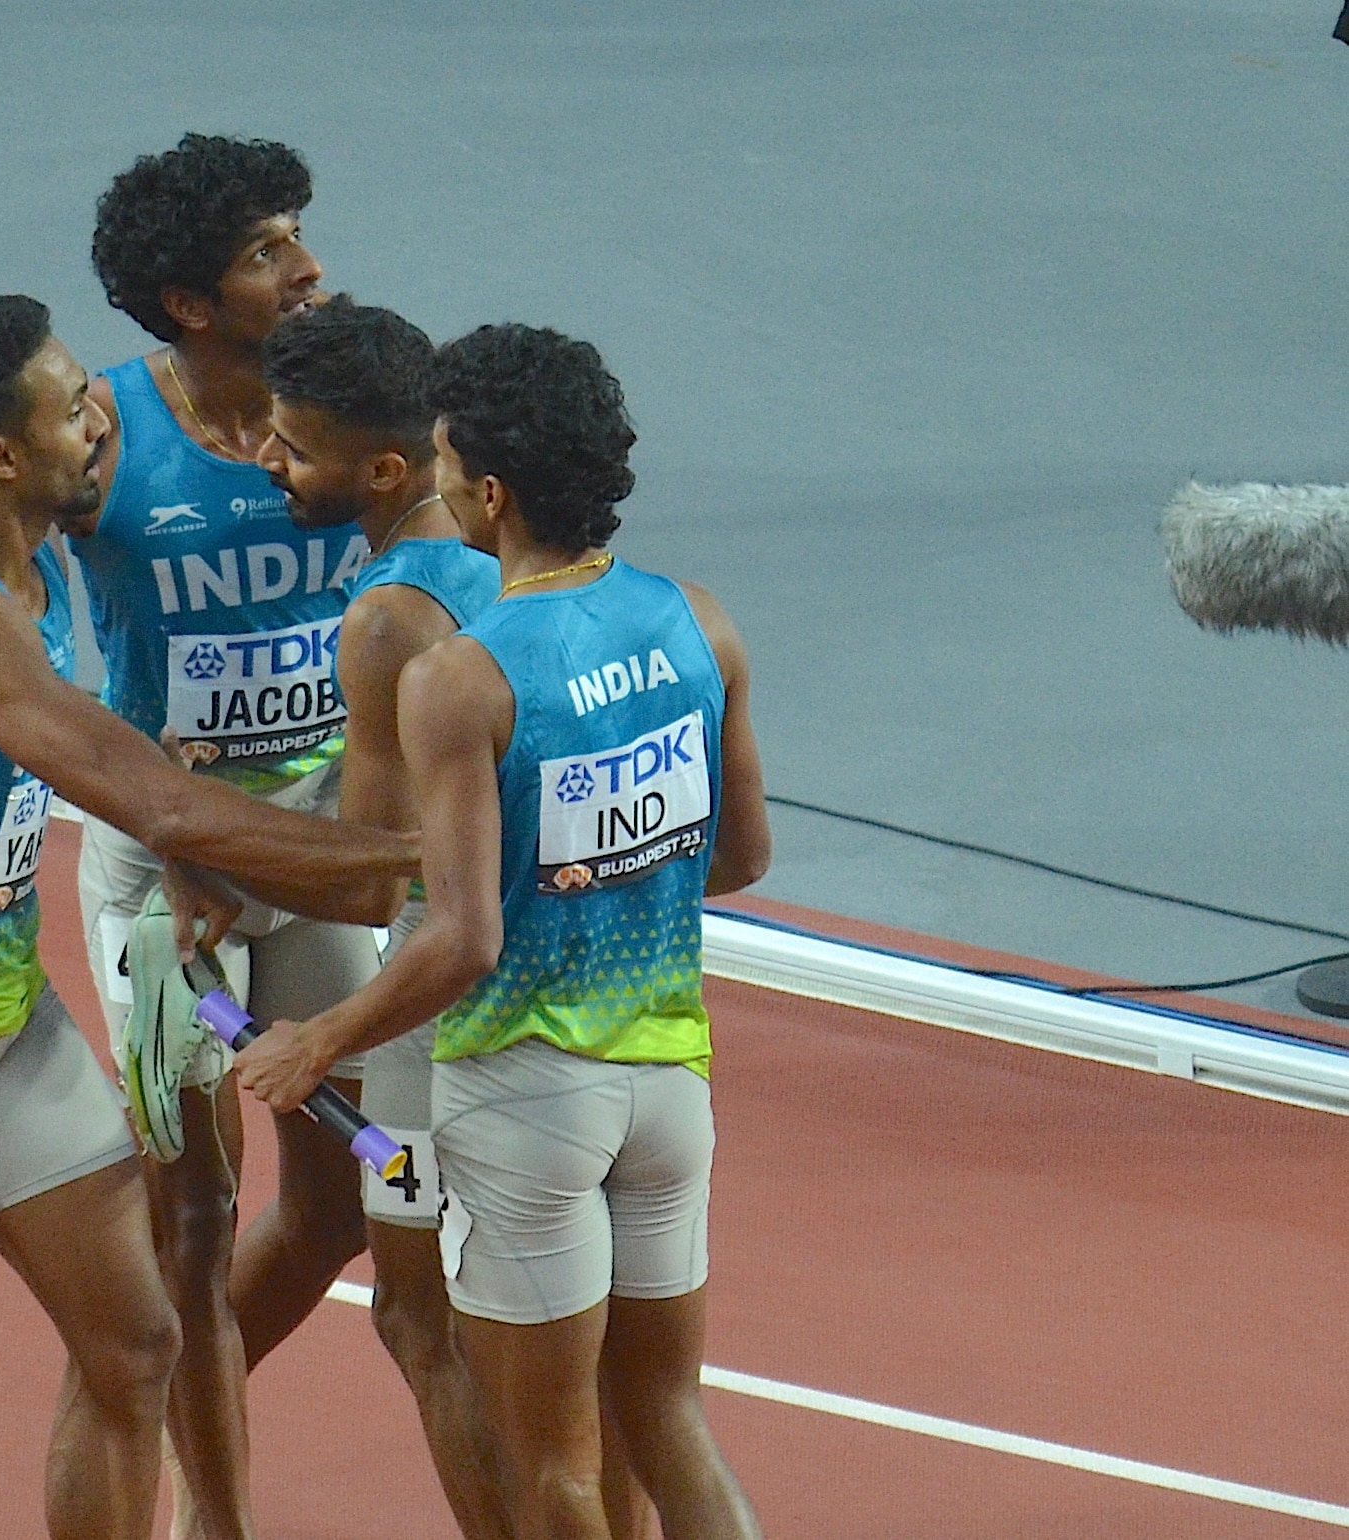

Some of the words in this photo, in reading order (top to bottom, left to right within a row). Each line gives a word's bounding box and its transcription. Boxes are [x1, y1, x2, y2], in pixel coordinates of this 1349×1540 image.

[151, 535, 368, 615] INDIA
[227, 624, 340, 679] TDK
[196, 679, 338, 731] JACOB
[567, 648, 679, 717] INDIA
[595, 725, 693, 795] TDK
[597, 791, 665, 849] IND
[386, 1145, 421, 1203] 4
